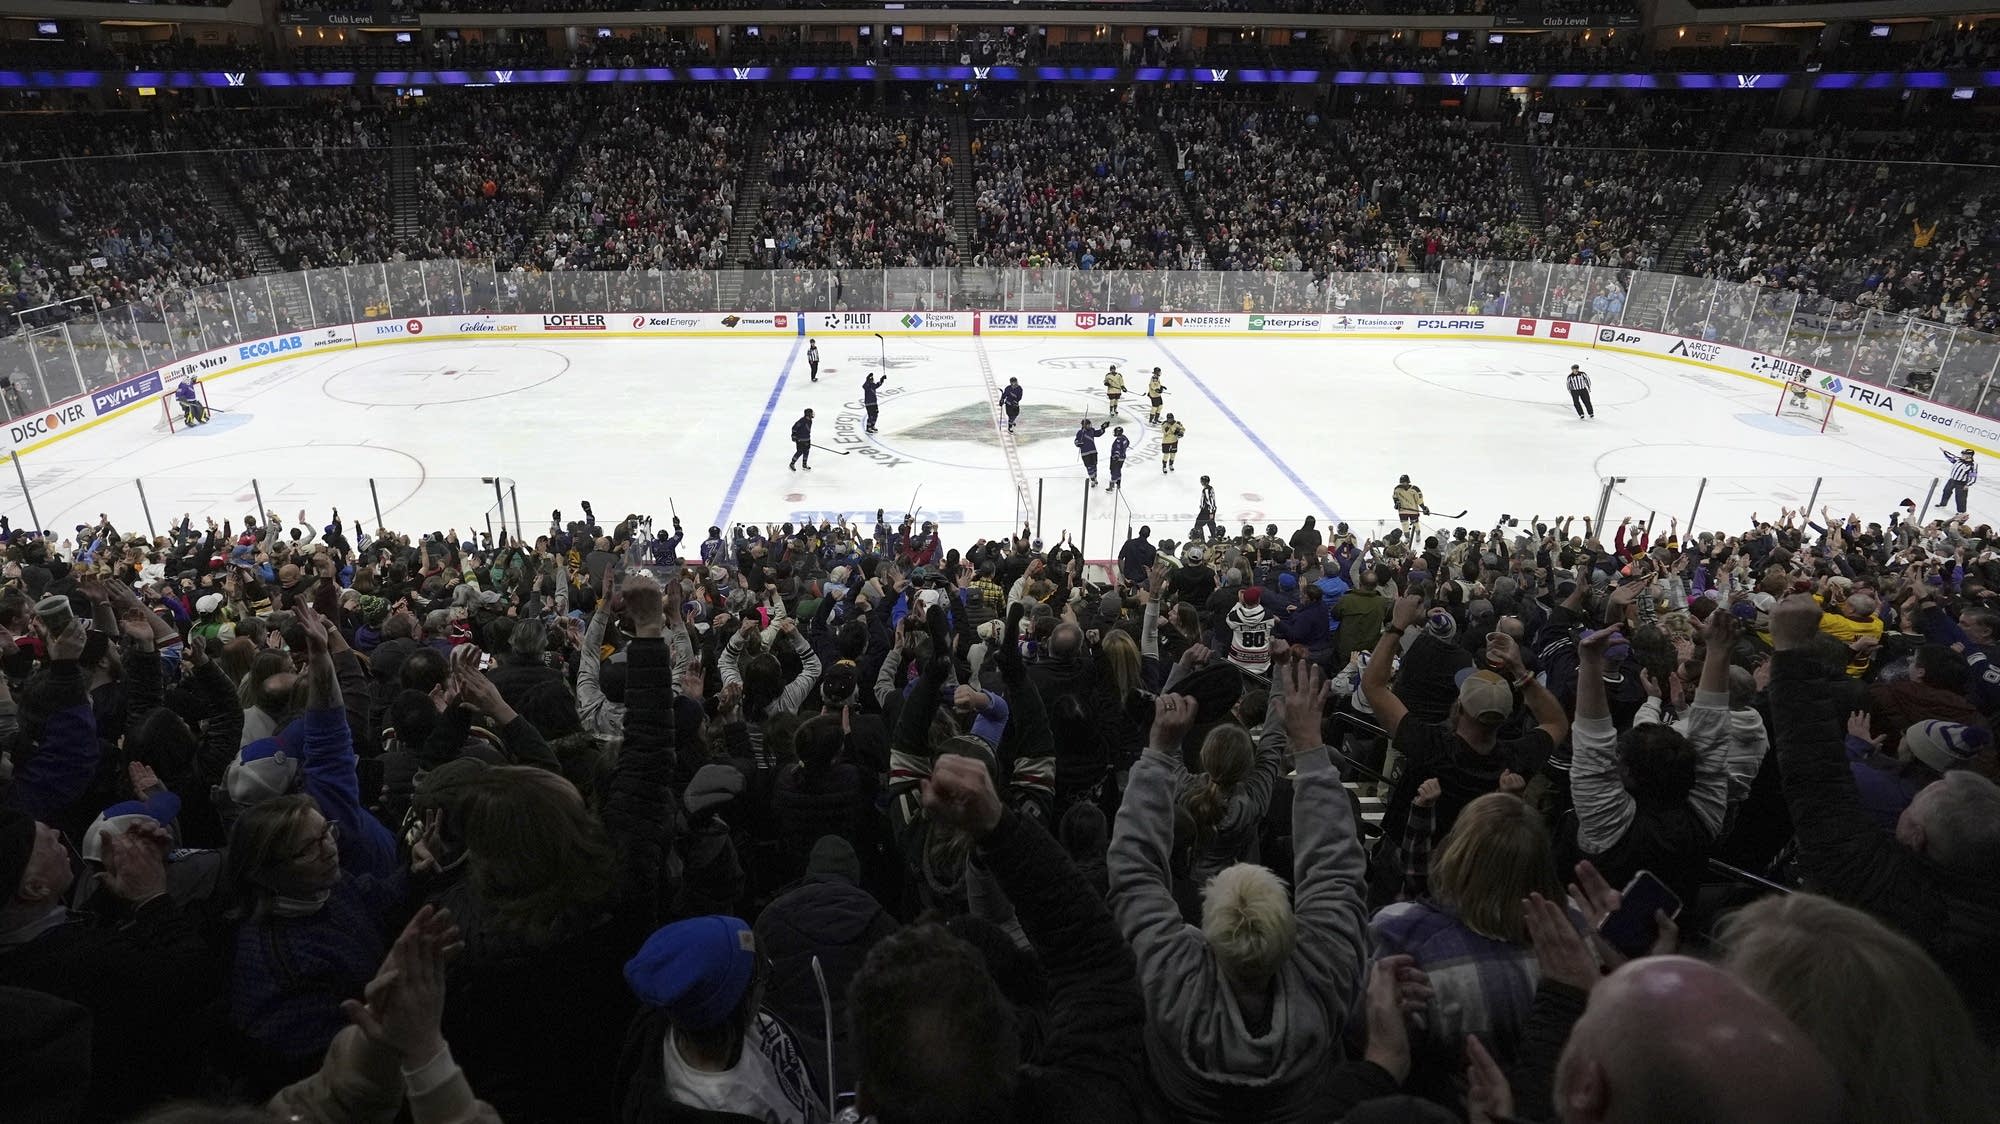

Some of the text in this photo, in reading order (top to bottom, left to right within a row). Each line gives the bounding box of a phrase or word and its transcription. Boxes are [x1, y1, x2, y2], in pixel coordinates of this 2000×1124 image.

[328, 14, 374, 24] Club Level
[1543, 17, 1588, 26] Club Level
[543, 315, 605, 325] LOFFLER
[844, 313, 871, 324] PILOT
[925, 313, 954, 321] Regions
[989, 315, 1018, 324] KFAN
[1027, 315, 1056, 324] KFAN
[1077, 314, 1132, 326] us bank
[1184, 317, 1231, 325] ANDERSEN
[459, 321, 494, 332] Golden
[649, 318, 698, 327] Xcel Energy
[925, 320, 956, 329] Hospital
[1250, 318, 1320, 328] enterprise
[1417, 320, 1485, 329] POLARIS
[1519, 323, 1534, 331] Cub
[376, 325, 403, 335] BMO
[239, 335, 303, 360] ECOLAB
[1688, 342, 1721, 355] ARCTIC
[1690, 351, 1716, 361] WOLF
[170, 369, 181, 377] The
[199, 355, 227, 370] Shop
[1772, 359, 1801, 376] PILOT
[96, 385, 140, 409] PWHL
[1849, 384, 1893, 411] TRIA
[11, 404, 85, 443] DISCOVER
[1920, 410, 2000, 441] bread financial
[1242, 631, 1266, 648] 80
